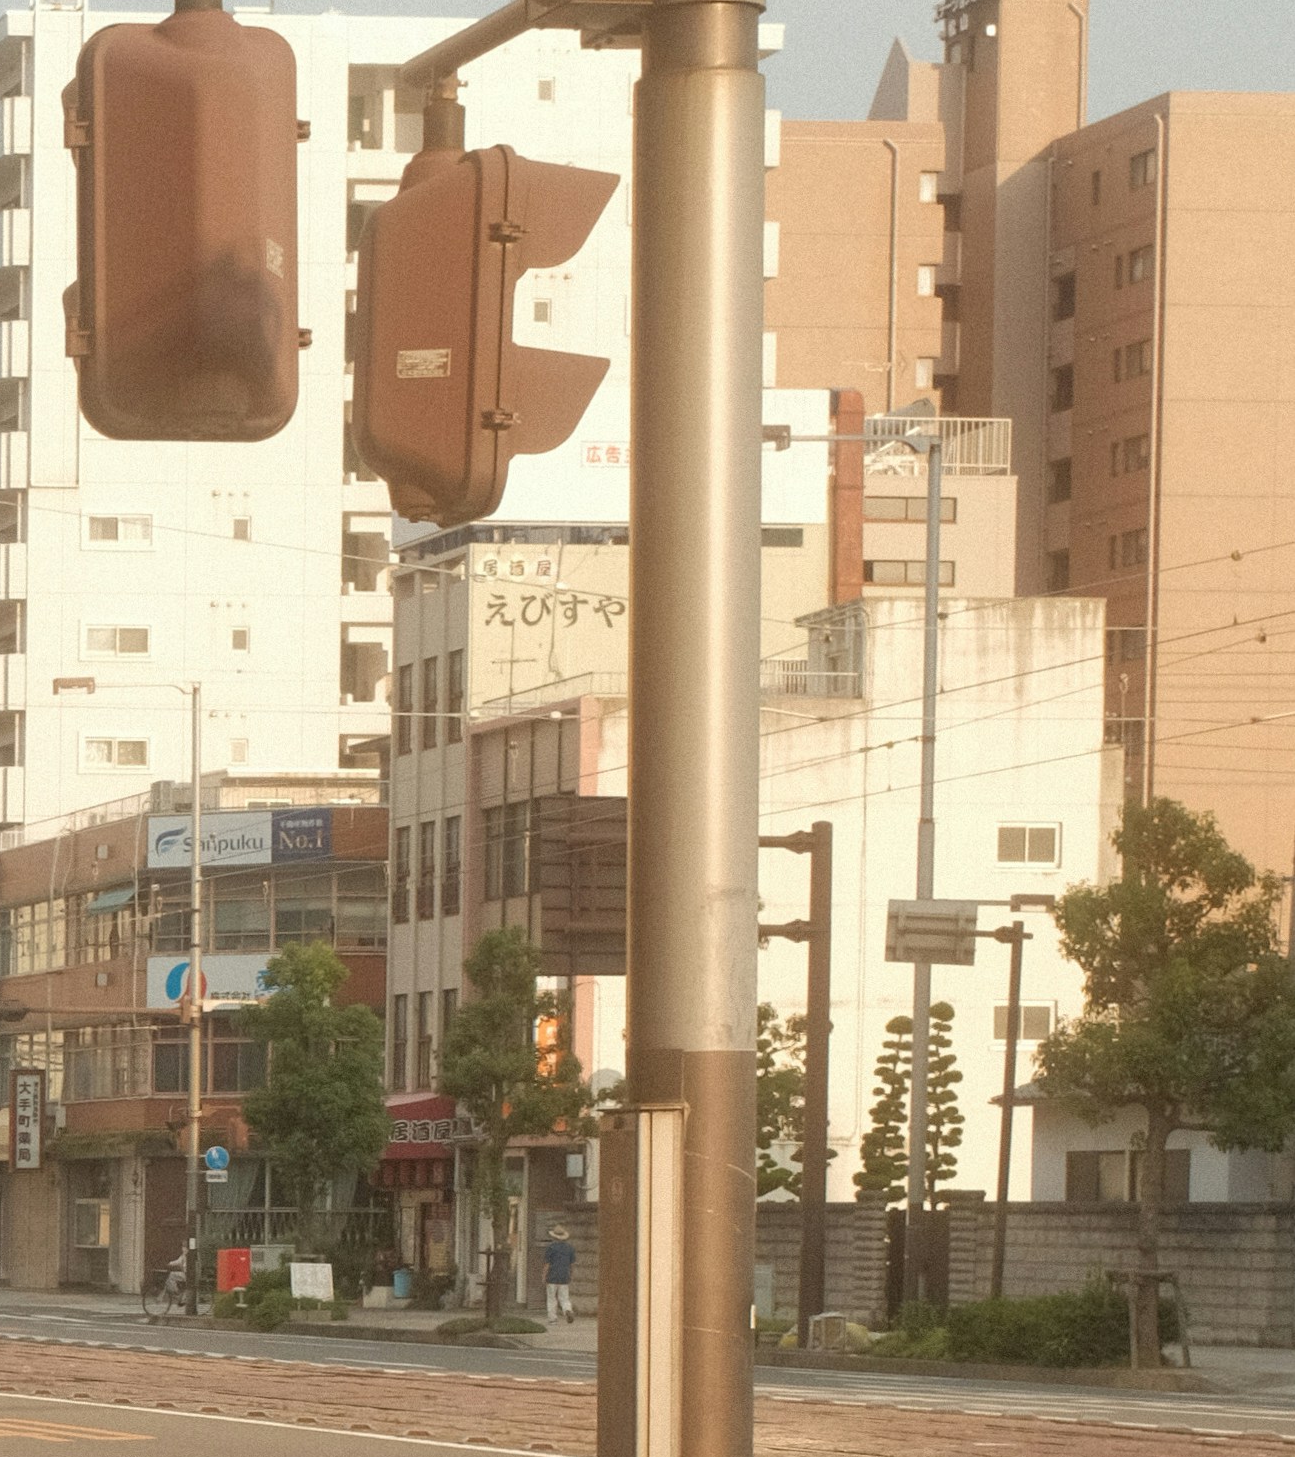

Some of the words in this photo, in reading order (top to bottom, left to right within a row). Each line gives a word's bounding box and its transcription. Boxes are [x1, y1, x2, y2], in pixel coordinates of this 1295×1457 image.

[586, 446, 630, 464] 広告
[484, 559, 551, 576] 居酒屋
[485, 593, 626, 628] えびすや
[279, 830, 323, 849] No.1
